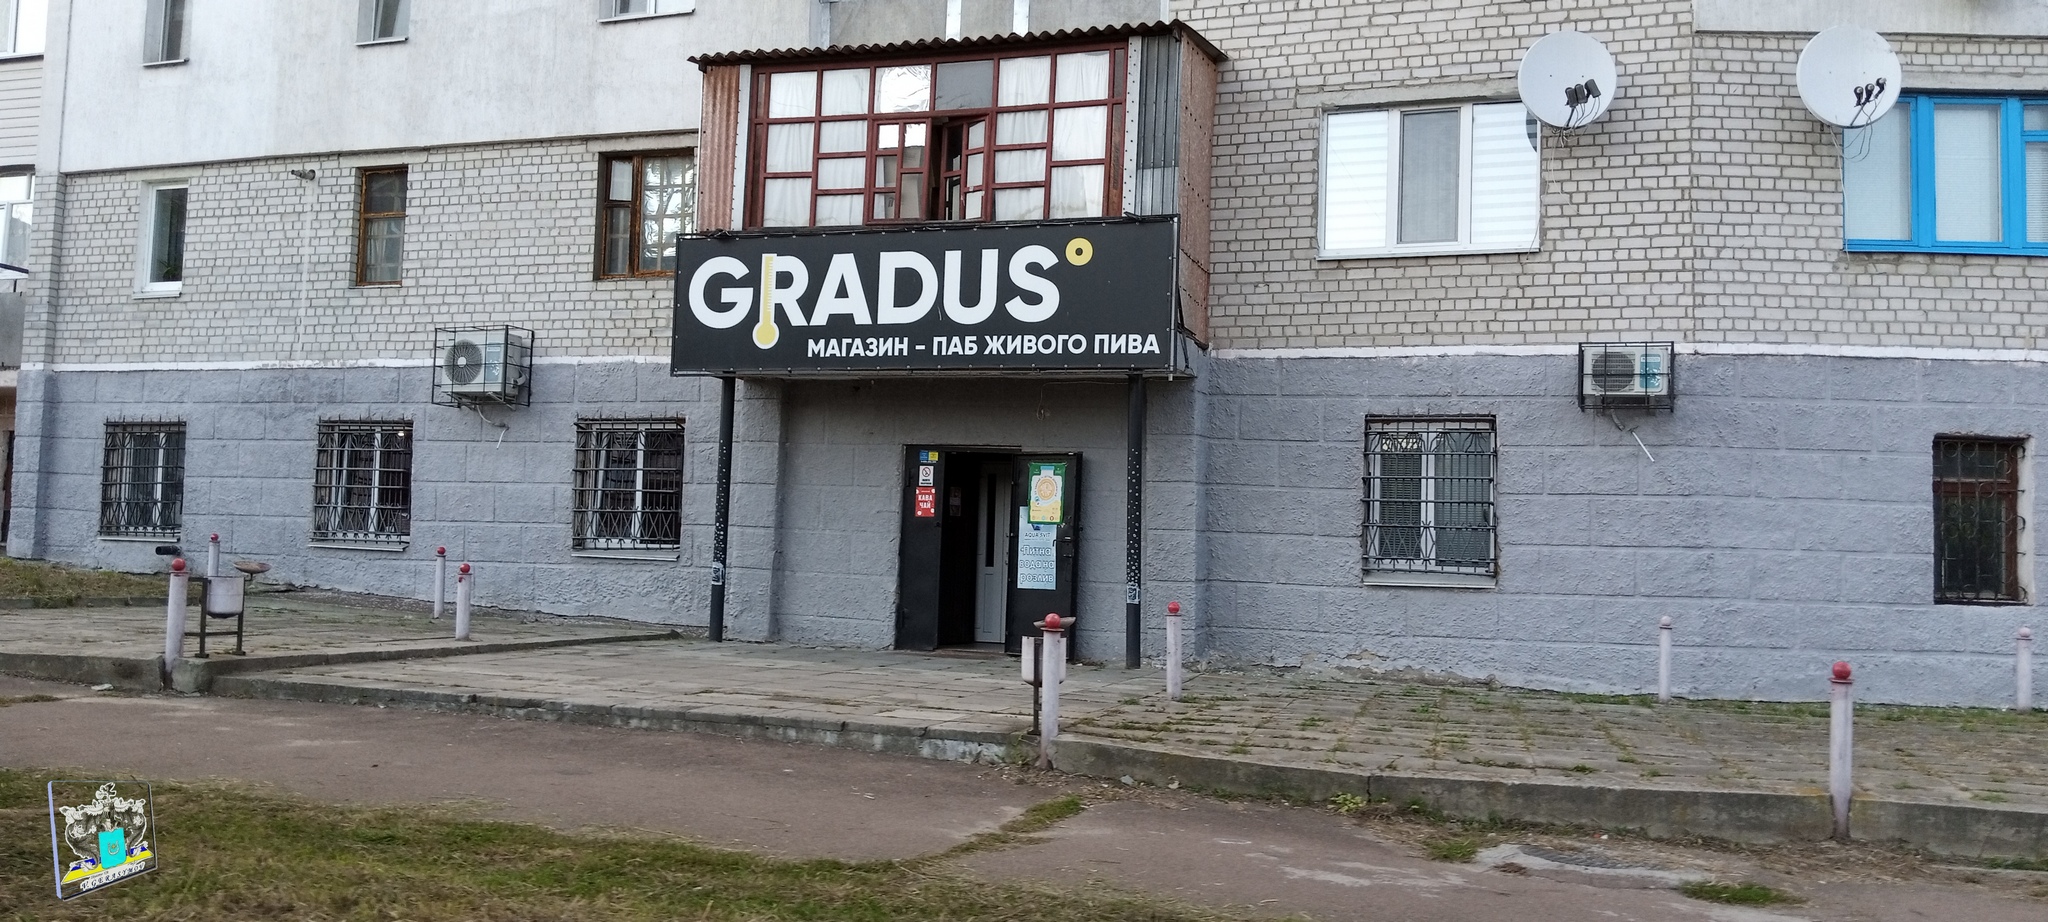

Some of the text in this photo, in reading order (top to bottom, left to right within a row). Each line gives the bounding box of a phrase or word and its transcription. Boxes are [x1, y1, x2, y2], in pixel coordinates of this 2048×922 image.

[807, 335, 909, 358] МАГАЗИН
[932, 335, 978, 356] ПАБ
[984, 333, 1088, 355] ЖИВОГО
[1093, 333, 1161, 354] ПИВА
[1022, 545, 1051, 556] Питна
[1019, 560, 1054, 569] вода на
[1020, 573, 1054, 584] розлив
